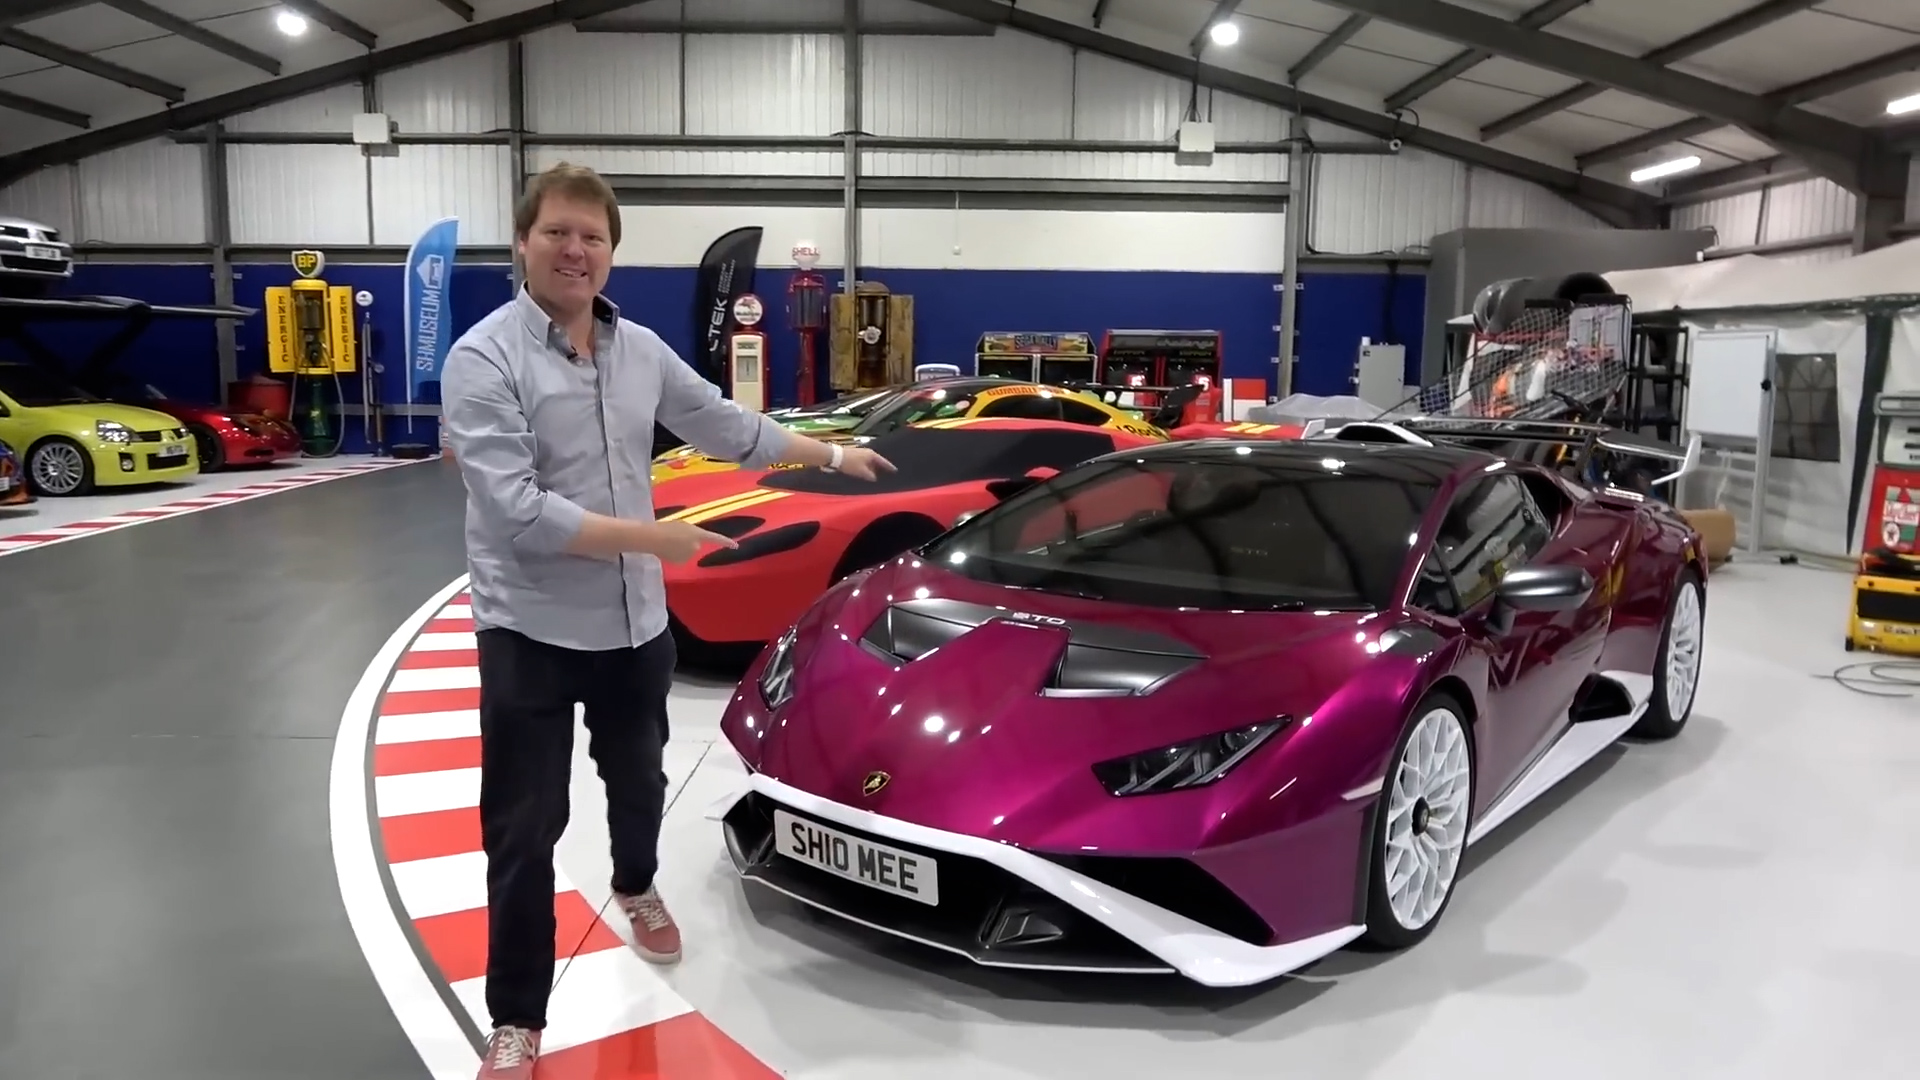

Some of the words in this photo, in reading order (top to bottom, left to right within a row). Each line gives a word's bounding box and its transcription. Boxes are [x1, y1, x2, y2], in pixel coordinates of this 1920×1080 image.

[297, 255, 317, 268] BP
[792, 247, 819, 257] SHELL
[277, 295, 290, 363] ENERGIC
[339, 295, 351, 363] ENERGIC
[416, 289, 442, 372] SHMUSEUM
[1012, 611, 1066, 625] STO
[791, 821, 849, 872] SH10
[857, 843, 919, 894] MEE
